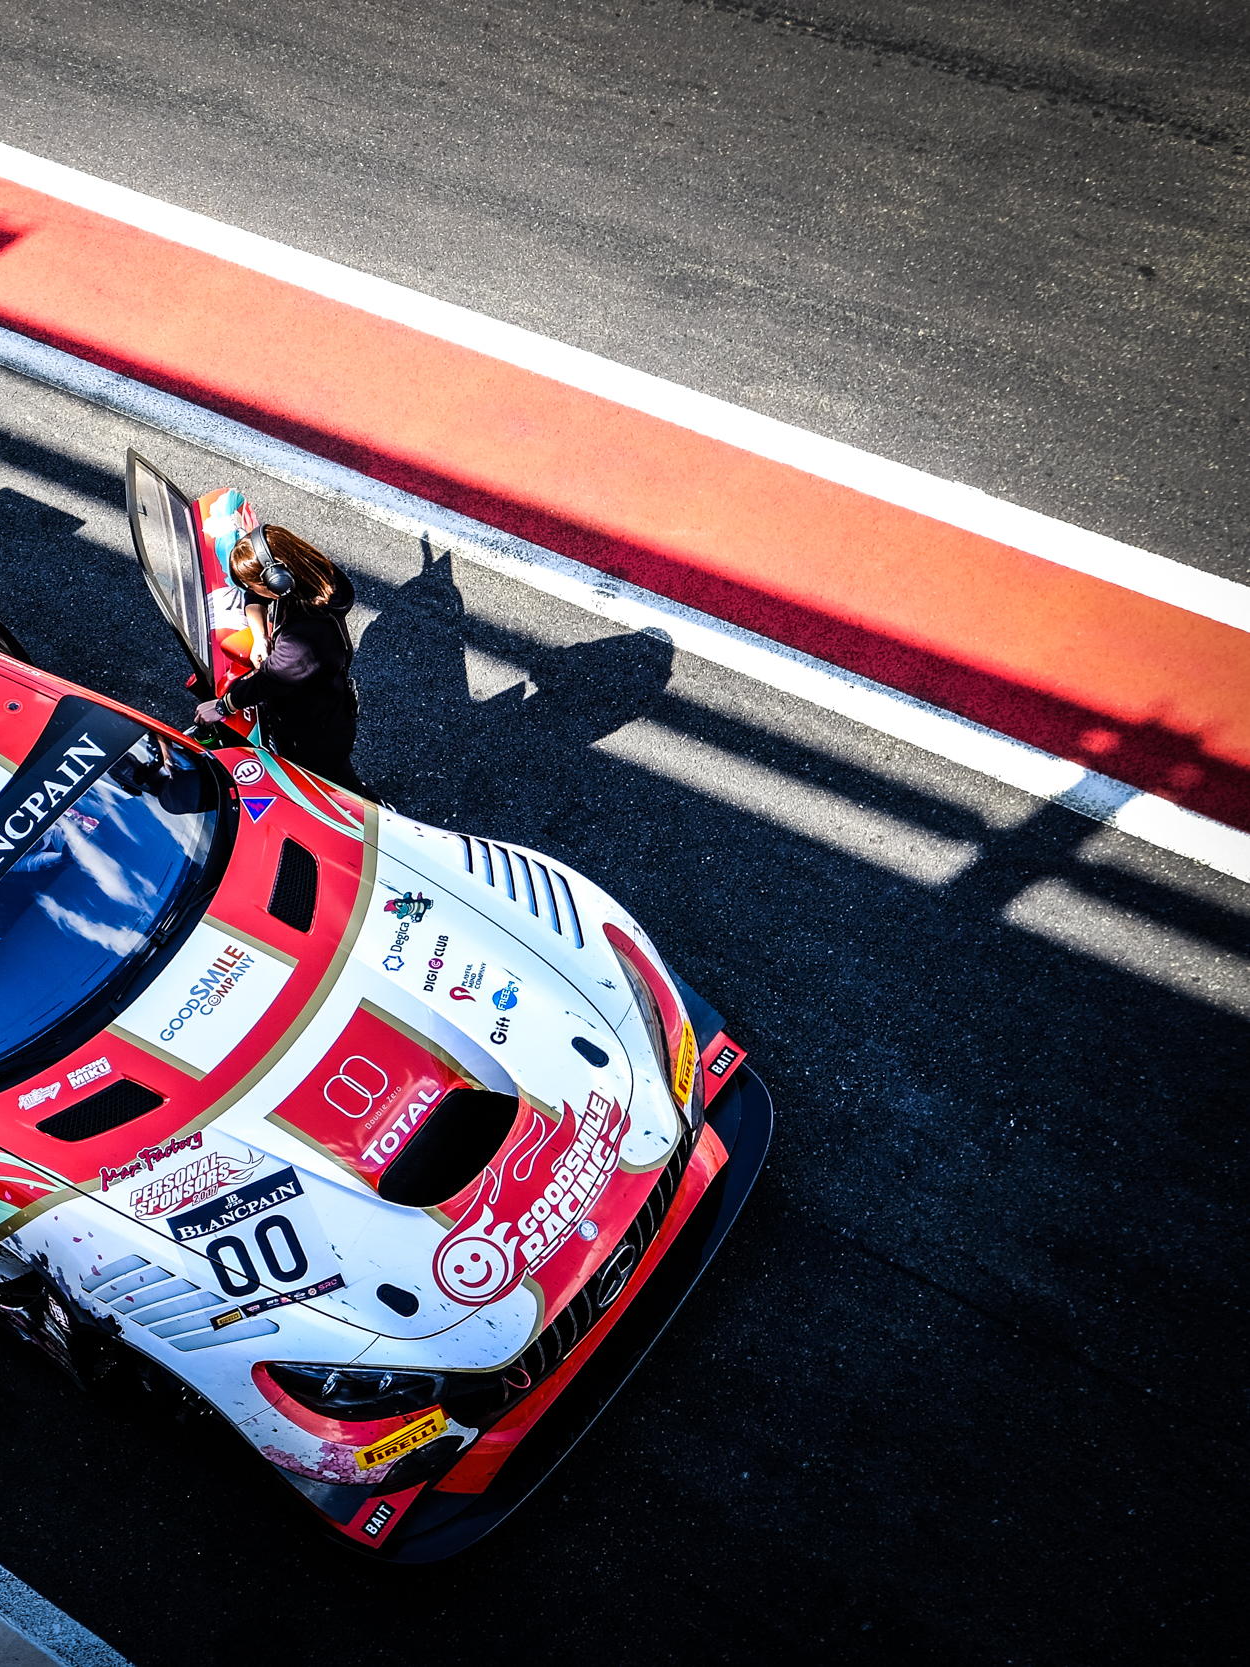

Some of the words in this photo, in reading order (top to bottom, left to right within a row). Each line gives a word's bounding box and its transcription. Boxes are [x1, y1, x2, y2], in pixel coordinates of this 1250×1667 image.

[390, 922, 410, 952] Degica
[461, 963, 473, 987] PLAYFUL
[468, 972, 477, 989] MIND
[474, 962, 487, 990] COMPANY
[490, 1017, 511, 1045] Gift
[66, 1056, 107, 1078] RACING
[69, 1062, 111, 1088] MIKU
[711, 1048, 735, 1075] BAIT
[364, 1104, 388, 1130] Double
[386, 1086, 402, 1103] Zero
[361, 1089, 441, 1165] TOTAL
[99, 1161, 141, 1192] Max
[137, 1131, 203, 1171] Factory
[129, 1151, 220, 1206] PERSONAL
[135, 1162, 231, 1219] SPONSORS
[191, 1184, 219, 1206] 2017
[519, 1135, 617, 1273] RACING
[176, 1181, 297, 1241] BLANCPAIN
[205, 1214, 308, 1297] 00
[363, 1418, 438, 1465] PIRELLI
[365, 1504, 392, 1535] BAIT
